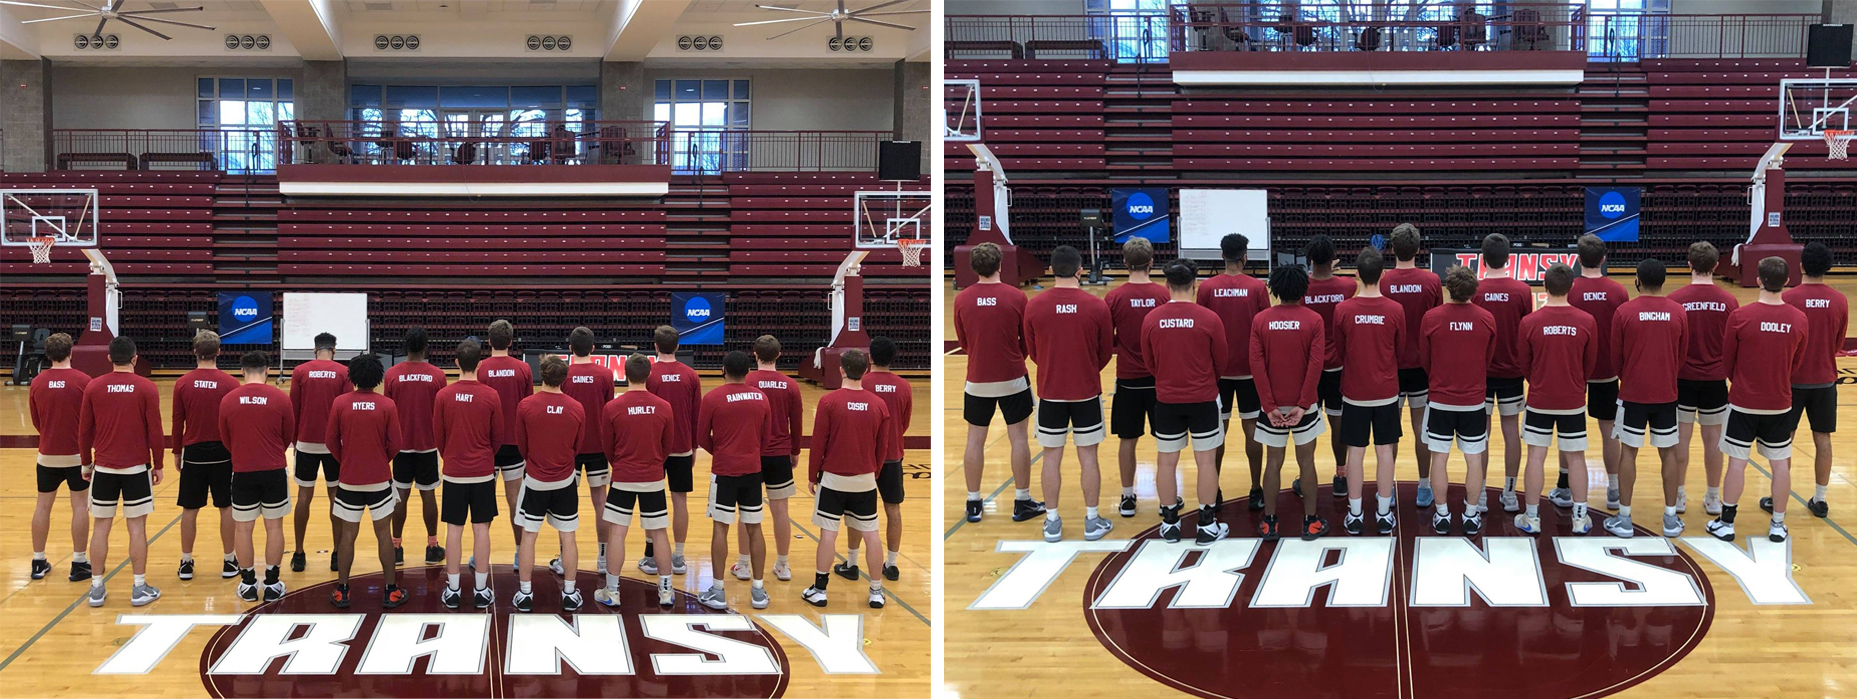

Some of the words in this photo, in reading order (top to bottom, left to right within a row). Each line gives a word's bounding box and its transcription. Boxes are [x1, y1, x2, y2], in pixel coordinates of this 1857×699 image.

[1129, 205, 1154, 213] NCAA
[1601, 204, 1625, 212] NCAA
[1214, 288, 1248, 298] LEACHMAN
[1390, 284, 1421, 294] BLANDON
[1305, 293, 1344, 305] BLACKFORD
[1485, 292, 1508, 302] GAINES
[1584, 291, 1606, 301] DENCE
[977, 296, 996, 307] BASS
[1130, 298, 1155, 308] TAYLOR
[1682, 301, 1725, 312] GREENFIELD
[1806, 298, 1830, 308] BERRY
[234, 308, 258, 316] NCAA
[687, 308, 710, 317] NCAA
[1056, 303, 1077, 314] RASH
[1355, 314, 1385, 325] CRUMBIE
[1639, 311, 1670, 322] BINGHAM
[1159, 318, 1194, 329] CUSTARD
[1269, 320, 1300, 331] HOOSIER
[1450, 321, 1472, 331] FLYNN
[1761, 321, 1791, 334] DOOLEY
[1543, 325, 1576, 337] ROBERTS
[308, 370, 337, 379] ROBERTS
[398, 373, 433, 383] BLACKFORD
[487, 368, 516, 378] BLANDON
[661, 373, 681, 383] DENCE
[48, 380, 66, 389] BASS
[194, 379, 217, 389] STATEN
[572, 375, 594, 384] GAINES
[758, 380, 787, 389] QUARLES
[106, 384, 135, 393] THOMAS
[874, 384, 897, 393] BERRY
[239, 395, 268, 406] WILSON
[455, 392, 474, 403] HART
[727, 391, 763, 402] RAINWATER
[352, 401, 376, 411] MYERS
[546, 405, 564, 415] CLAY
[627, 405, 656, 416] HURLEY
[846, 401, 869, 412] COSBY
[966, 536, 1812, 609] TRANSY
[91, 613, 882, 675] TRANSY
